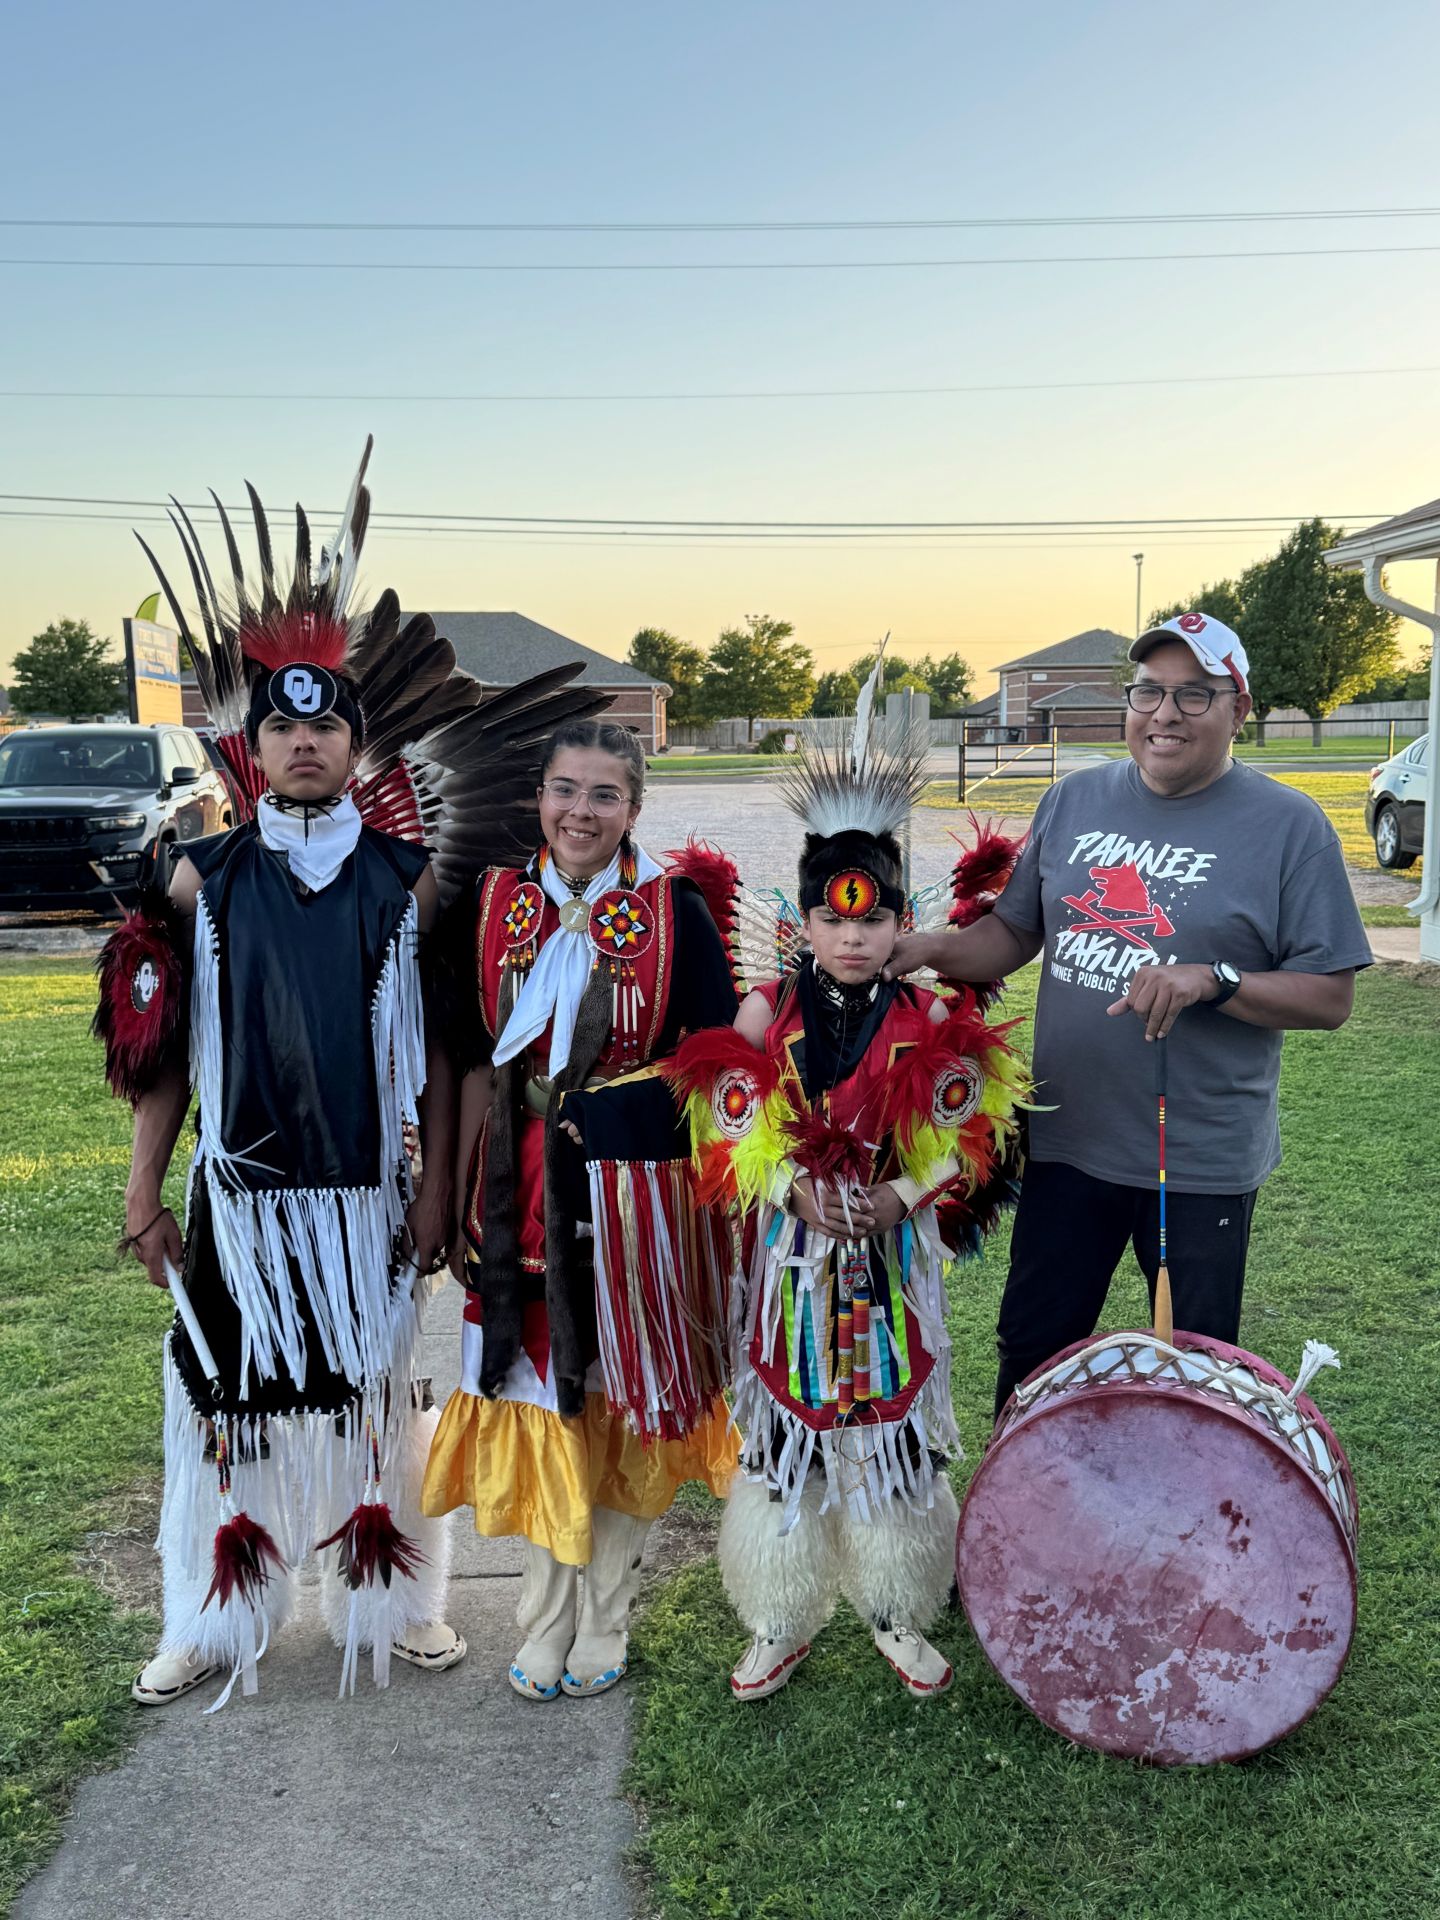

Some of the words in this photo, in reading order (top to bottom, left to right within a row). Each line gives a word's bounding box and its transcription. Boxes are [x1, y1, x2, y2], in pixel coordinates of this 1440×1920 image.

[284, 669, 321, 713] OU
[1067, 831, 1217, 883] PAWNEE
[1077, 971, 1116, 993] PUBLIC
